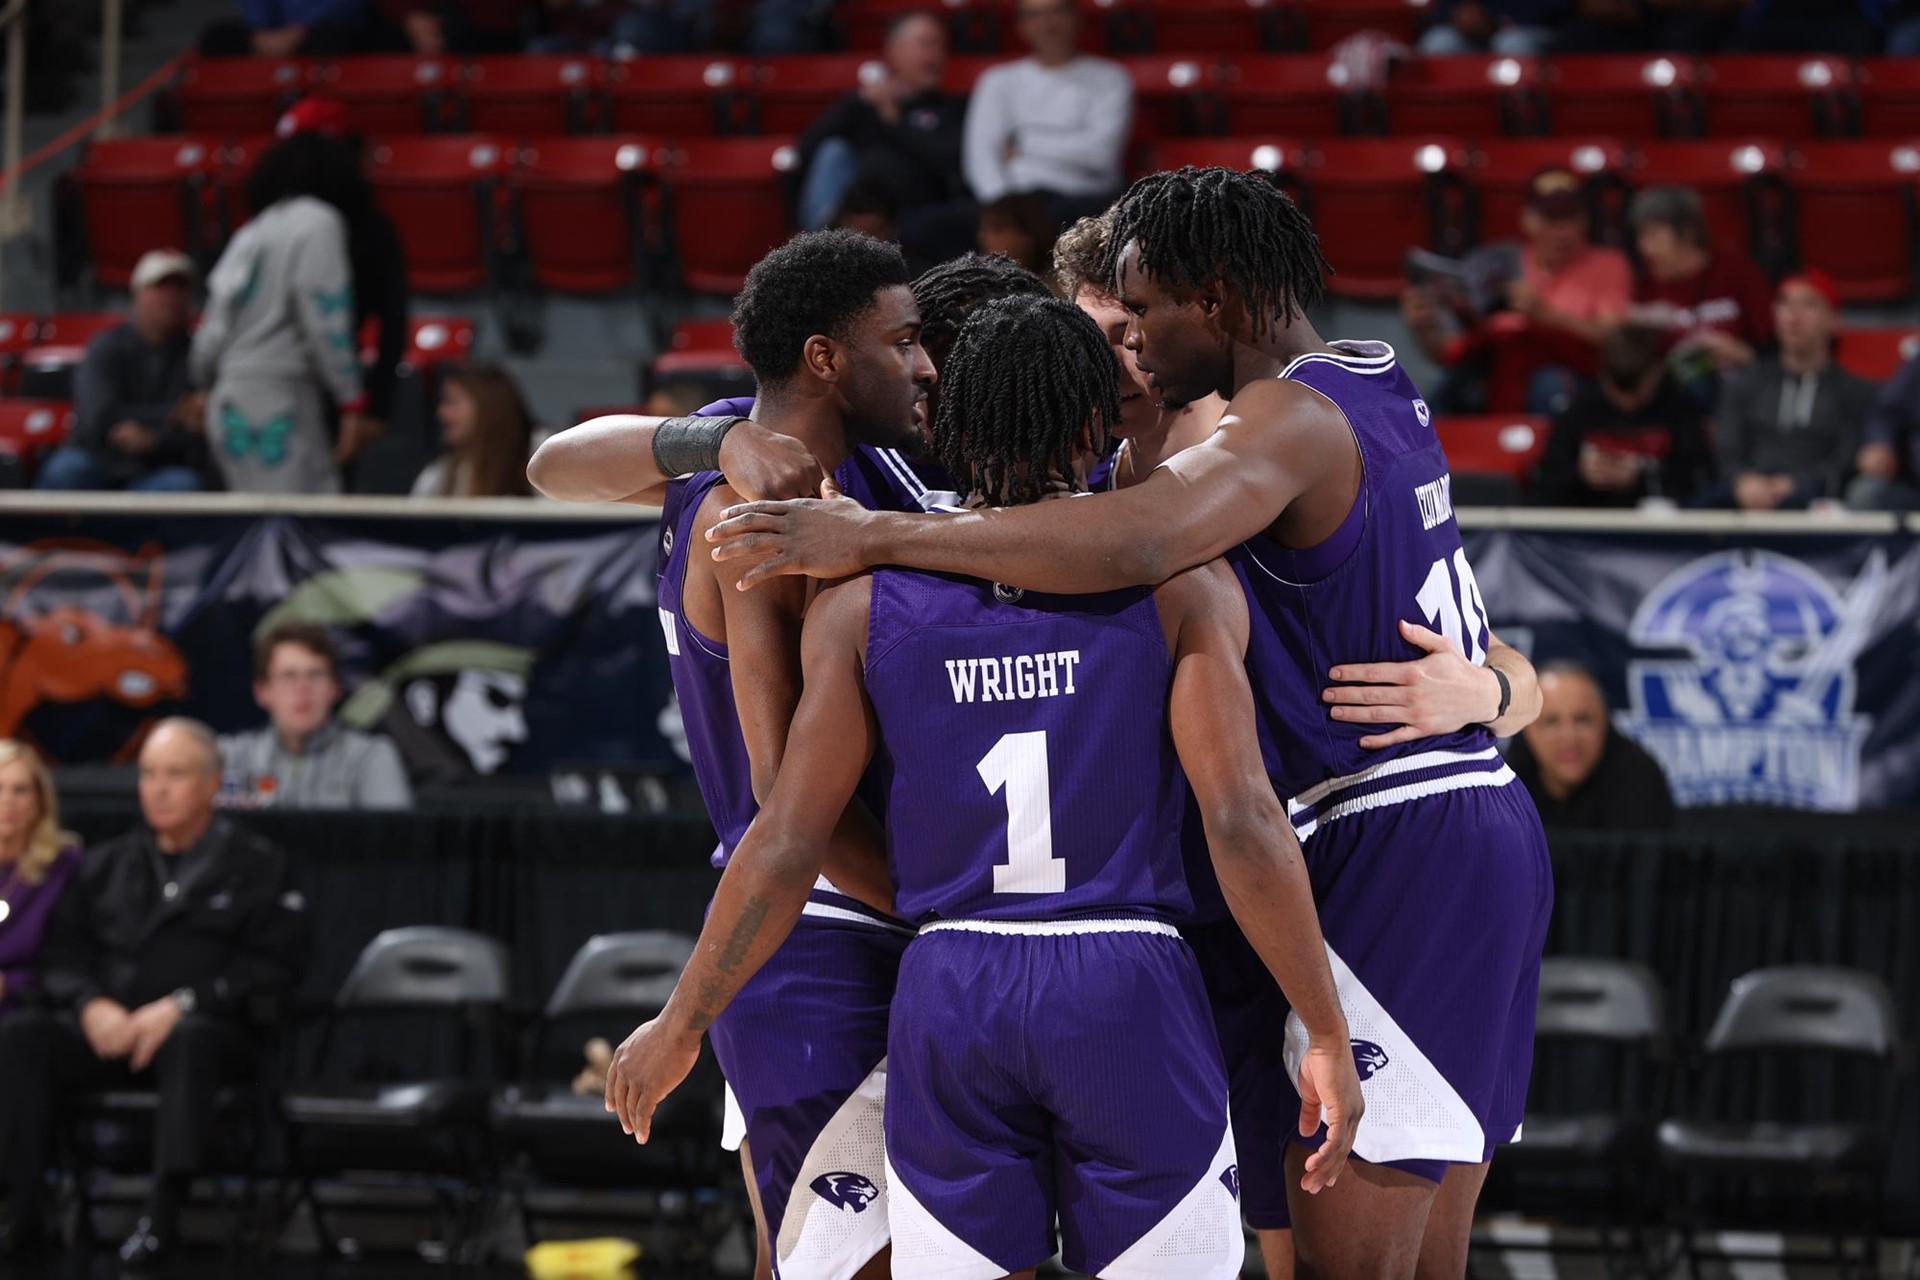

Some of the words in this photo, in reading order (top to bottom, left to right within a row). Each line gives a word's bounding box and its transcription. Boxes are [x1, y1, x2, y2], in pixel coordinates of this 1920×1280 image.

[1415, 546, 1490, 667] 10
[945, 650, 1080, 703] WRIGHT
[976, 730, 1066, 894] 1
